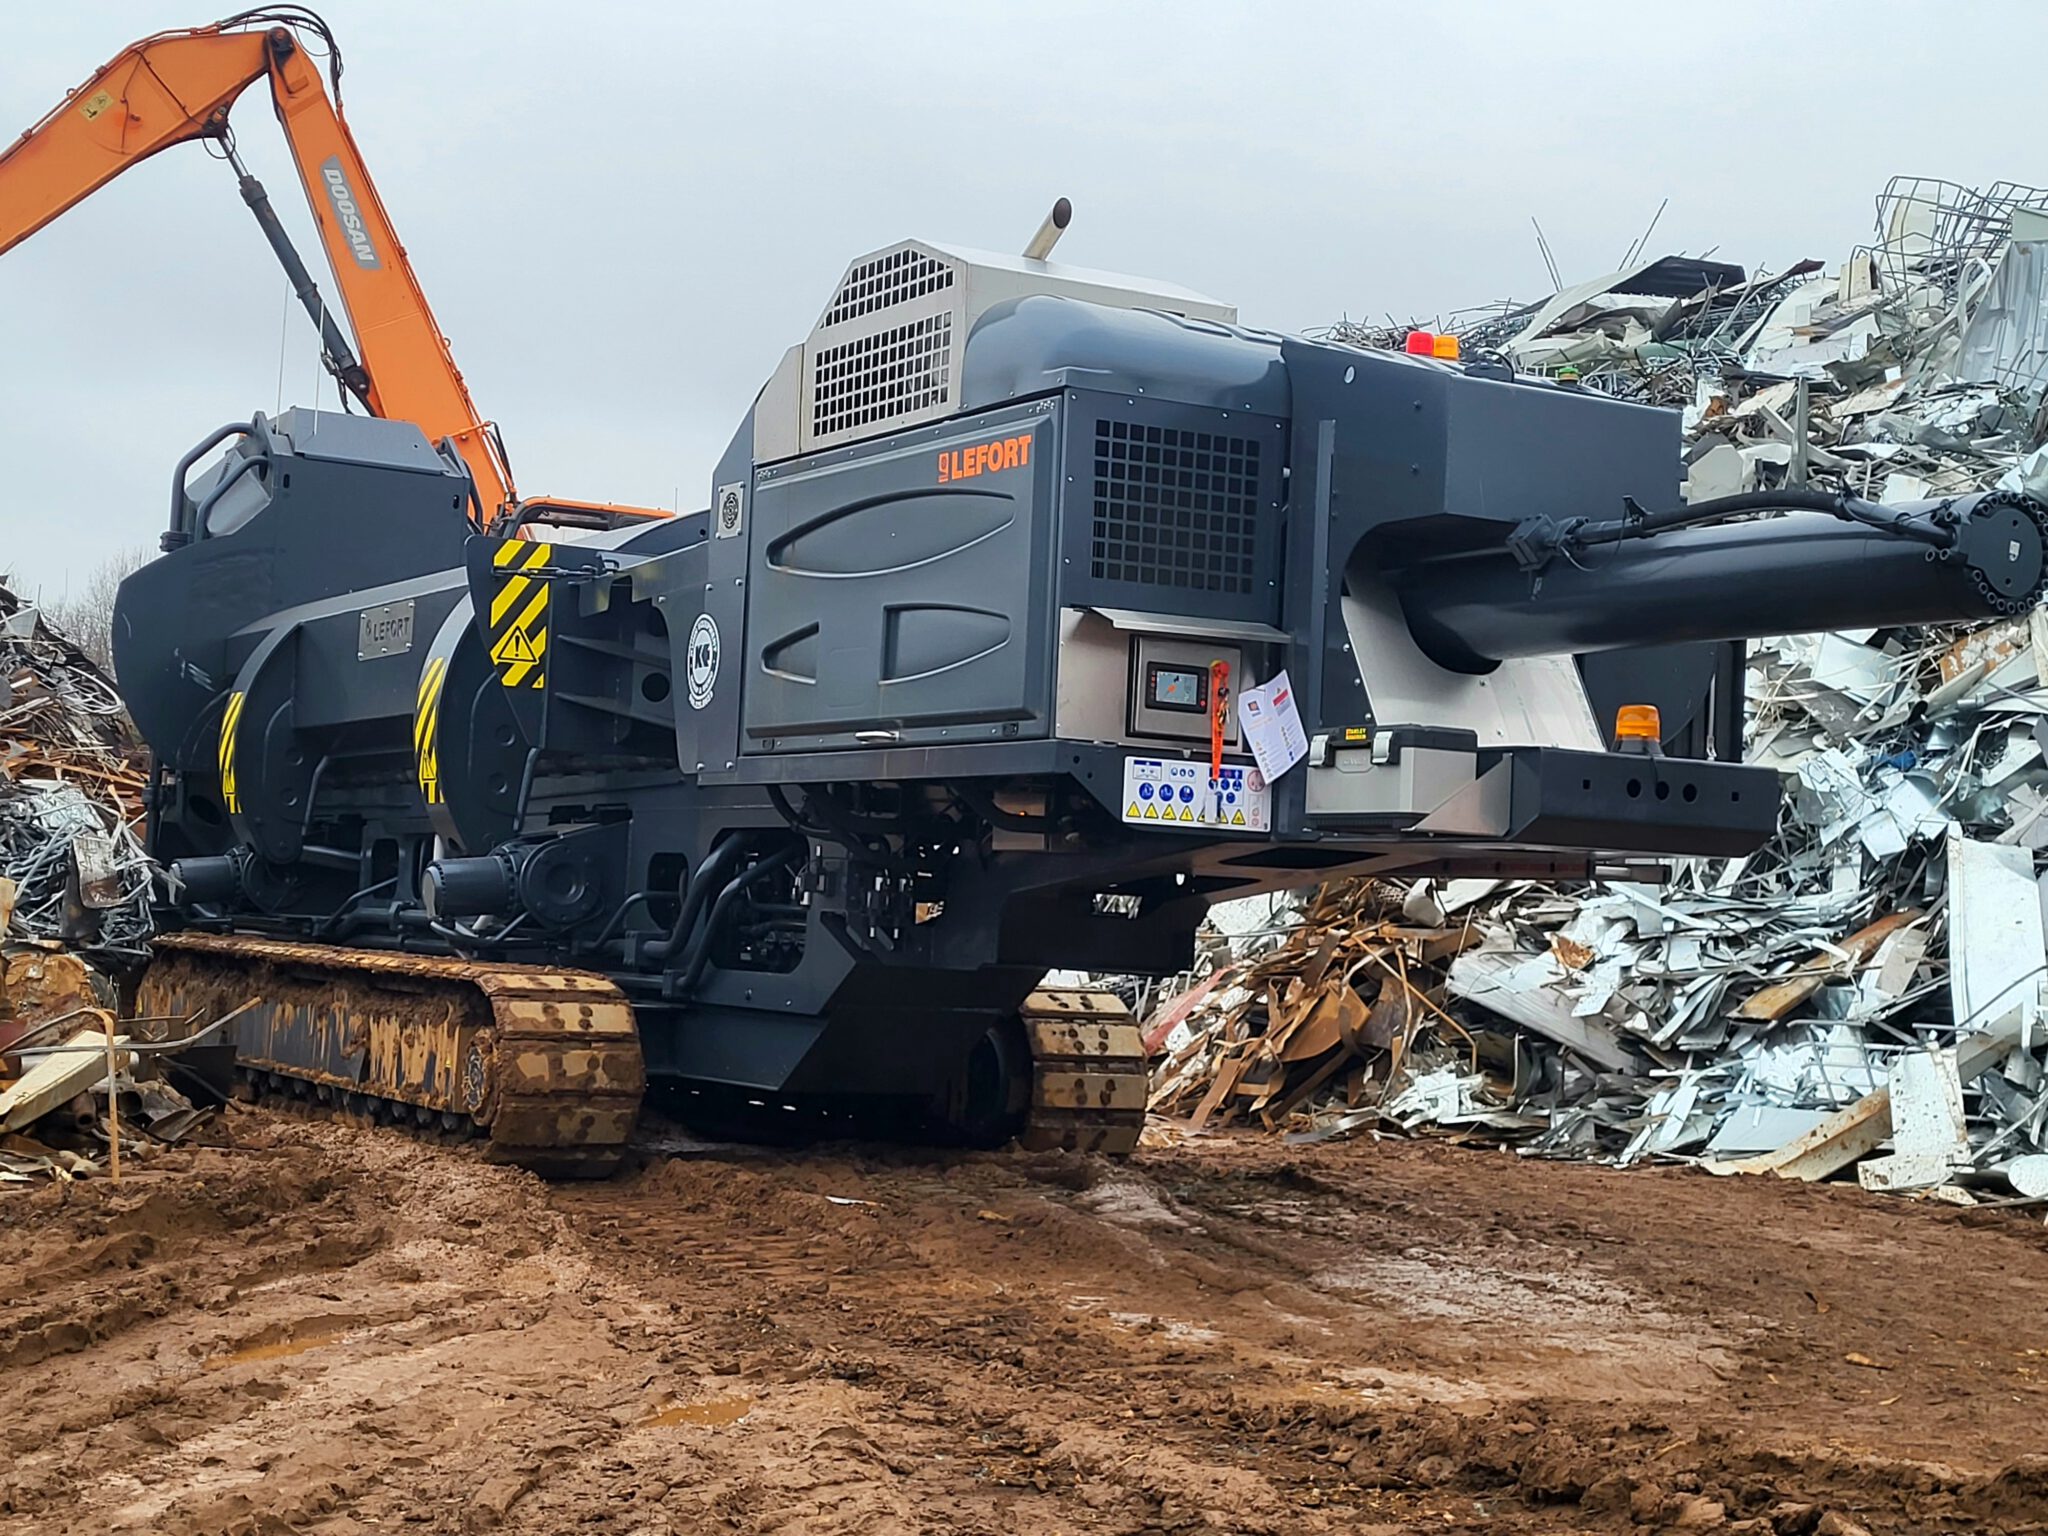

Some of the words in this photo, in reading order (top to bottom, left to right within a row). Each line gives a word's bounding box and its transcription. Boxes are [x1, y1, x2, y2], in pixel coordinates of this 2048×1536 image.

[323, 169, 375, 261] DOOSAN
[951, 434, 1032, 480] LEFORT
[373, 616, 410, 642] LEFORT
